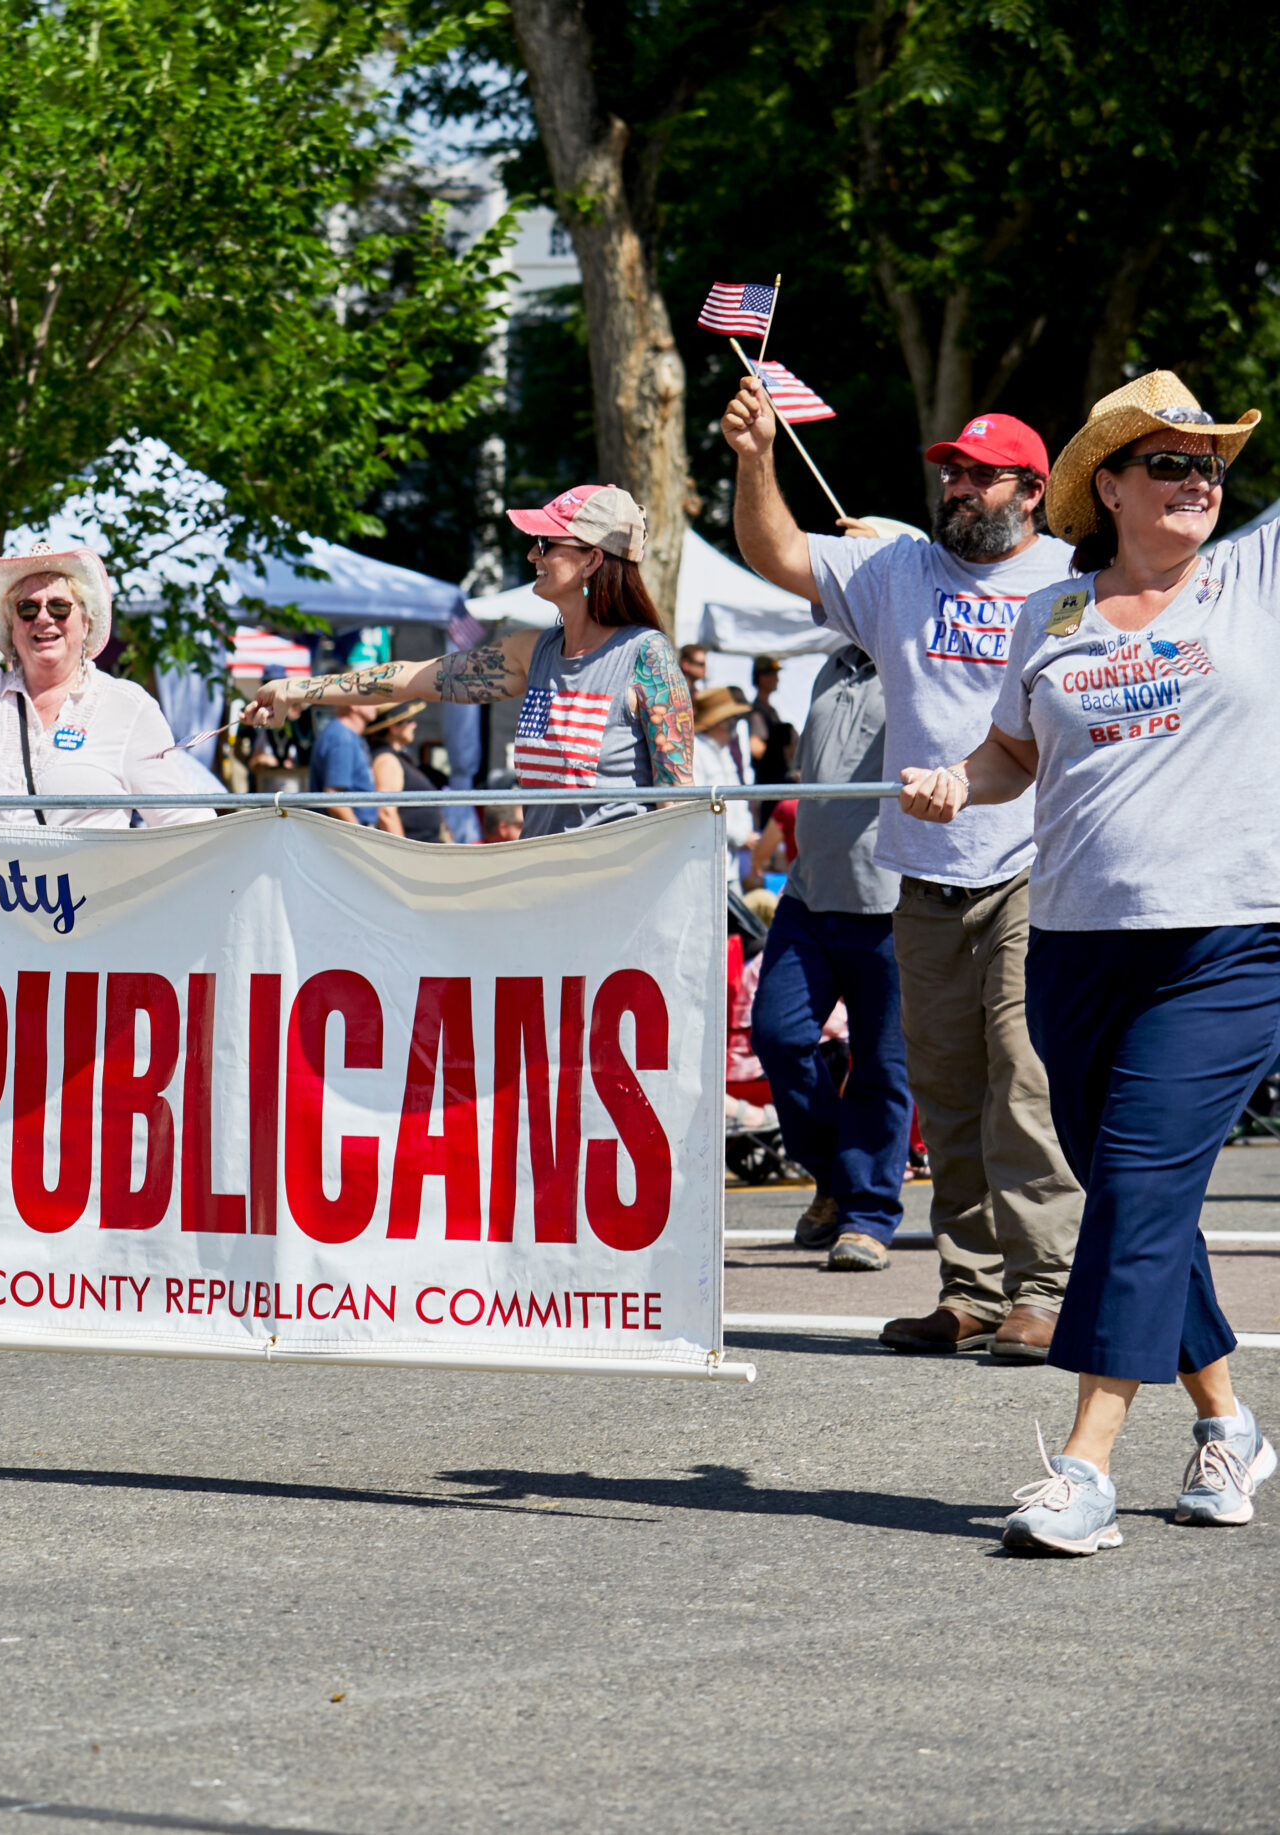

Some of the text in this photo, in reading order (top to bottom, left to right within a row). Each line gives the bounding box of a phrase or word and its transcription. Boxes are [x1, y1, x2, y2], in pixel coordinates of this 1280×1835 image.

[935, 588, 1024, 625] TRUM
[928, 621, 1007, 657] PENCE
[1088, 639, 1116, 657] Help
[1063, 658, 1160, 694] COUNTRY
[1080, 678, 1181, 713] Back NOW!
[1088, 713, 1181, 743] BE a PC
[165, 1277, 397, 1322] REPUBLICAN
[415, 1286, 663, 1331] COMMITTEE
